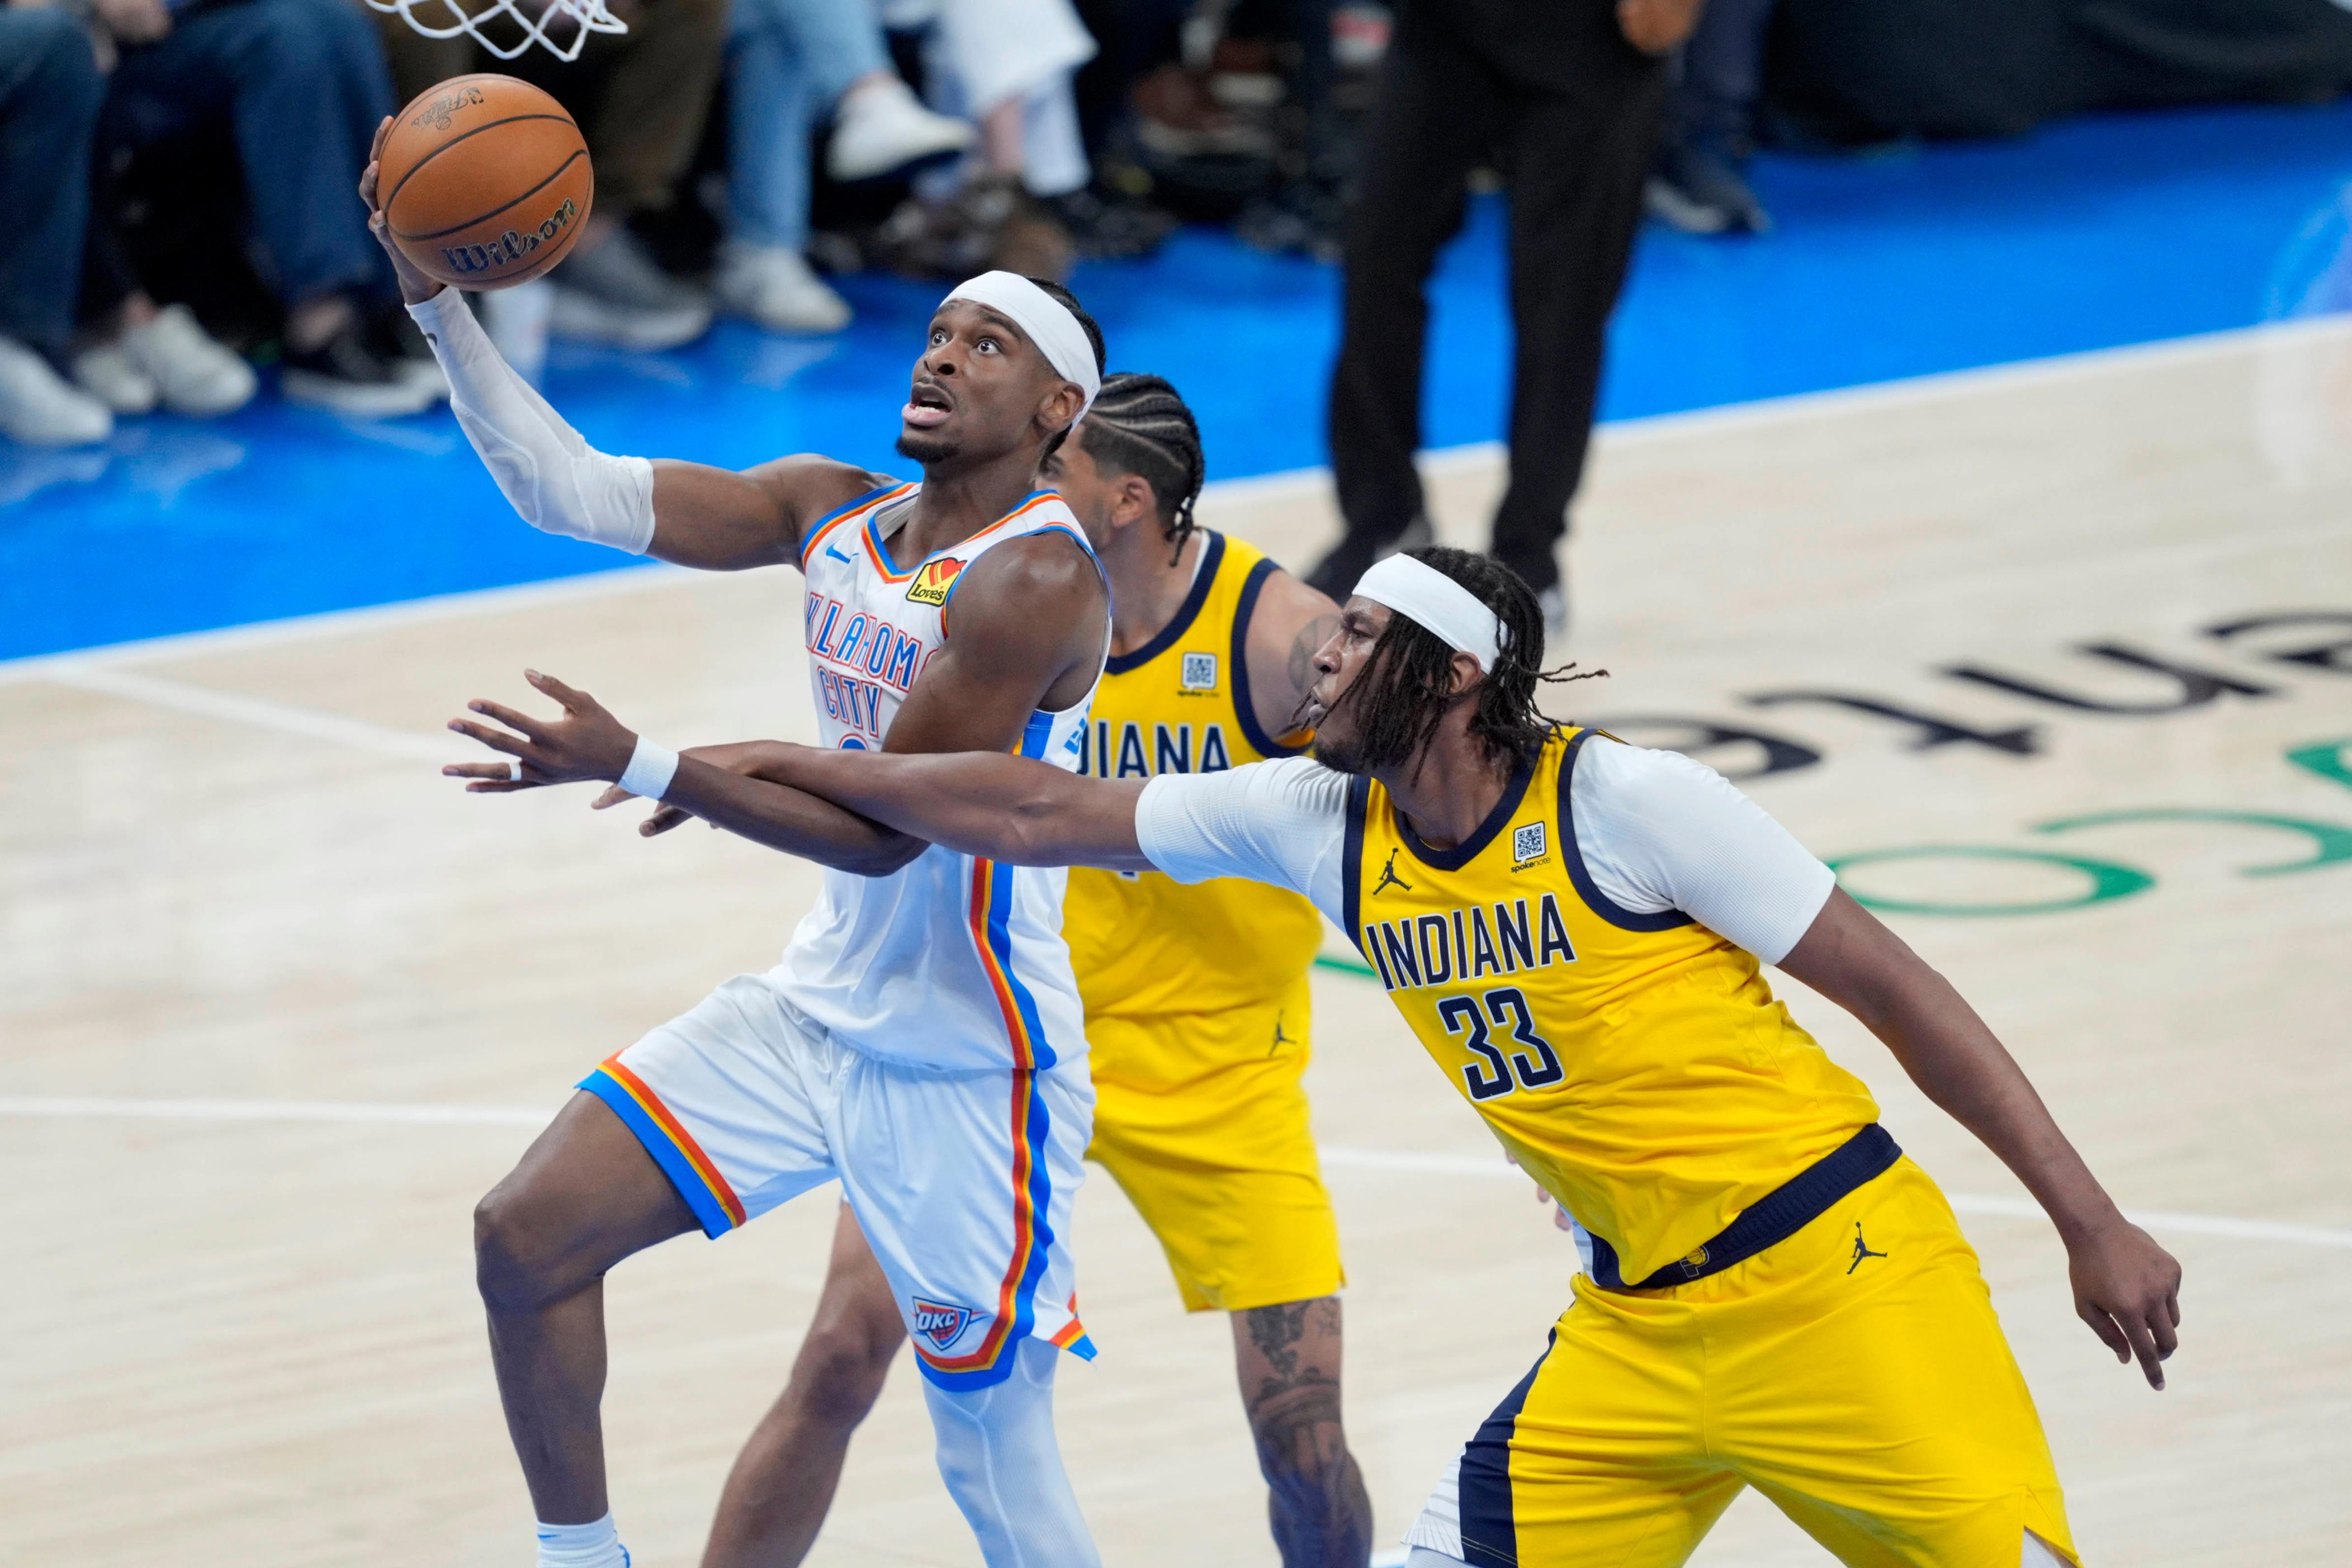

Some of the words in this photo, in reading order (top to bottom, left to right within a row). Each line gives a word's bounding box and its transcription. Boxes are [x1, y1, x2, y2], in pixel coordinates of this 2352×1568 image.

[441, 197, 577, 273] Wilson
[805, 591, 939, 693] KLAHOM
[817, 665, 883, 738] CITY
[1511, 857, 1551, 874] spokenote
[1364, 892, 1578, 993] INDIANA
[1436, 986, 1565, 1102] 33
[916, 1311, 957, 1331] OKC
